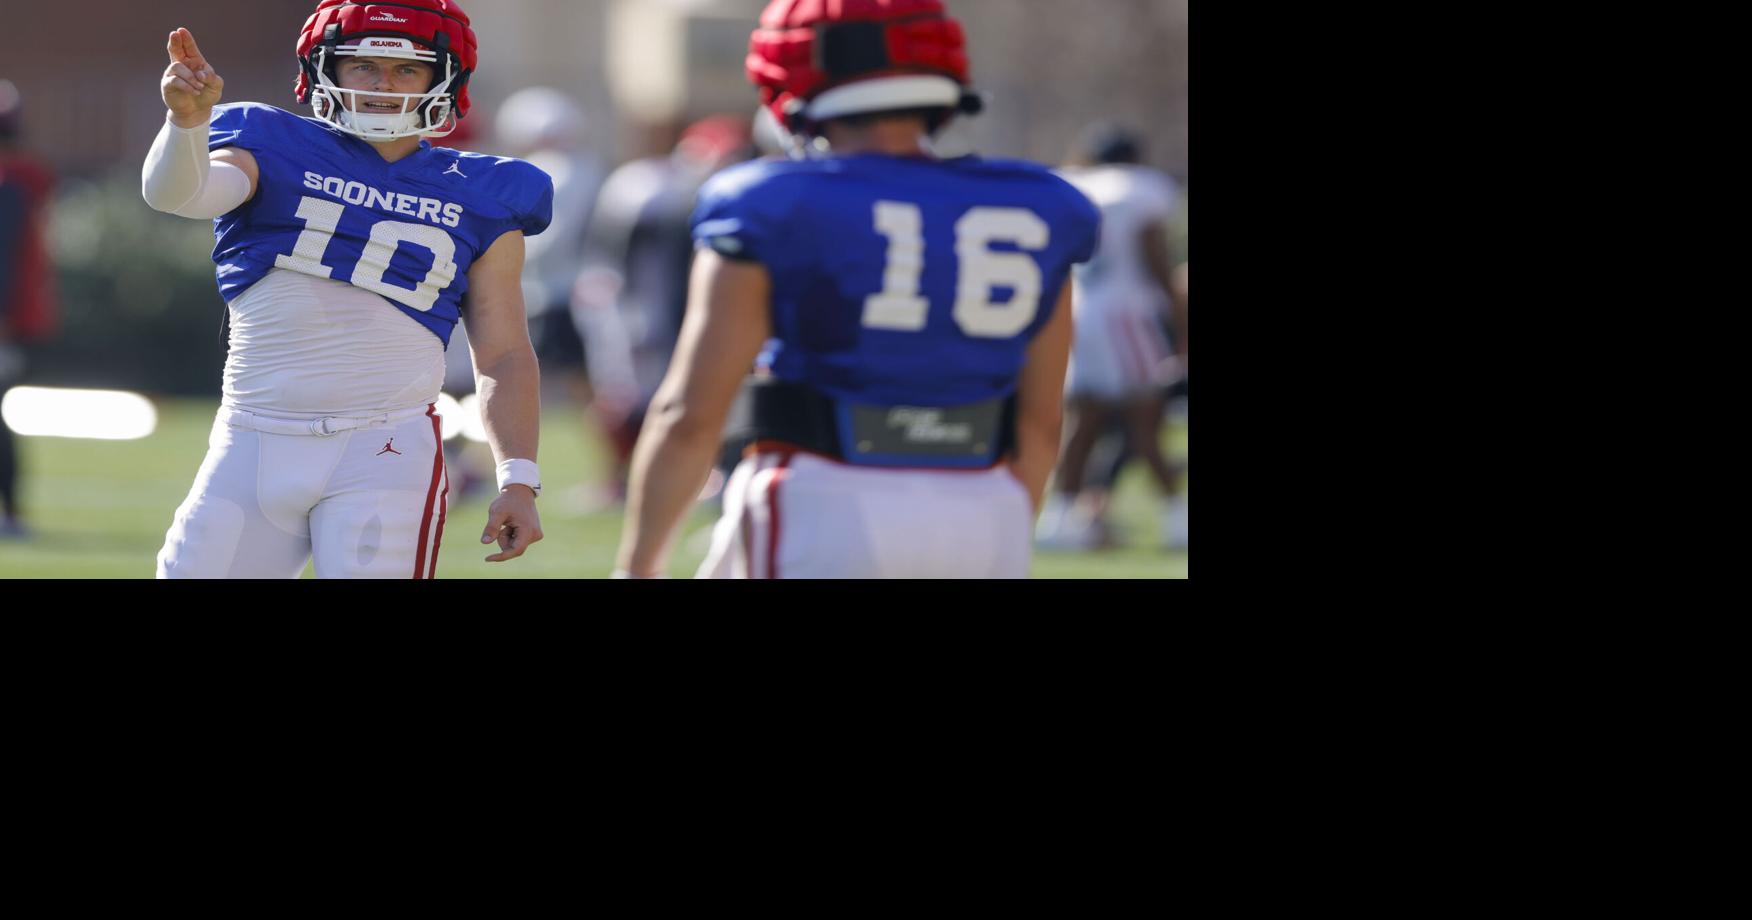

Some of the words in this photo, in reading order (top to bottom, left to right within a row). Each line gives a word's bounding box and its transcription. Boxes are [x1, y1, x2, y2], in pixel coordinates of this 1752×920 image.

[274, 196, 457, 312] 10
[303, 171, 464, 228] SOONERS
[861, 200, 1050, 338] 16
